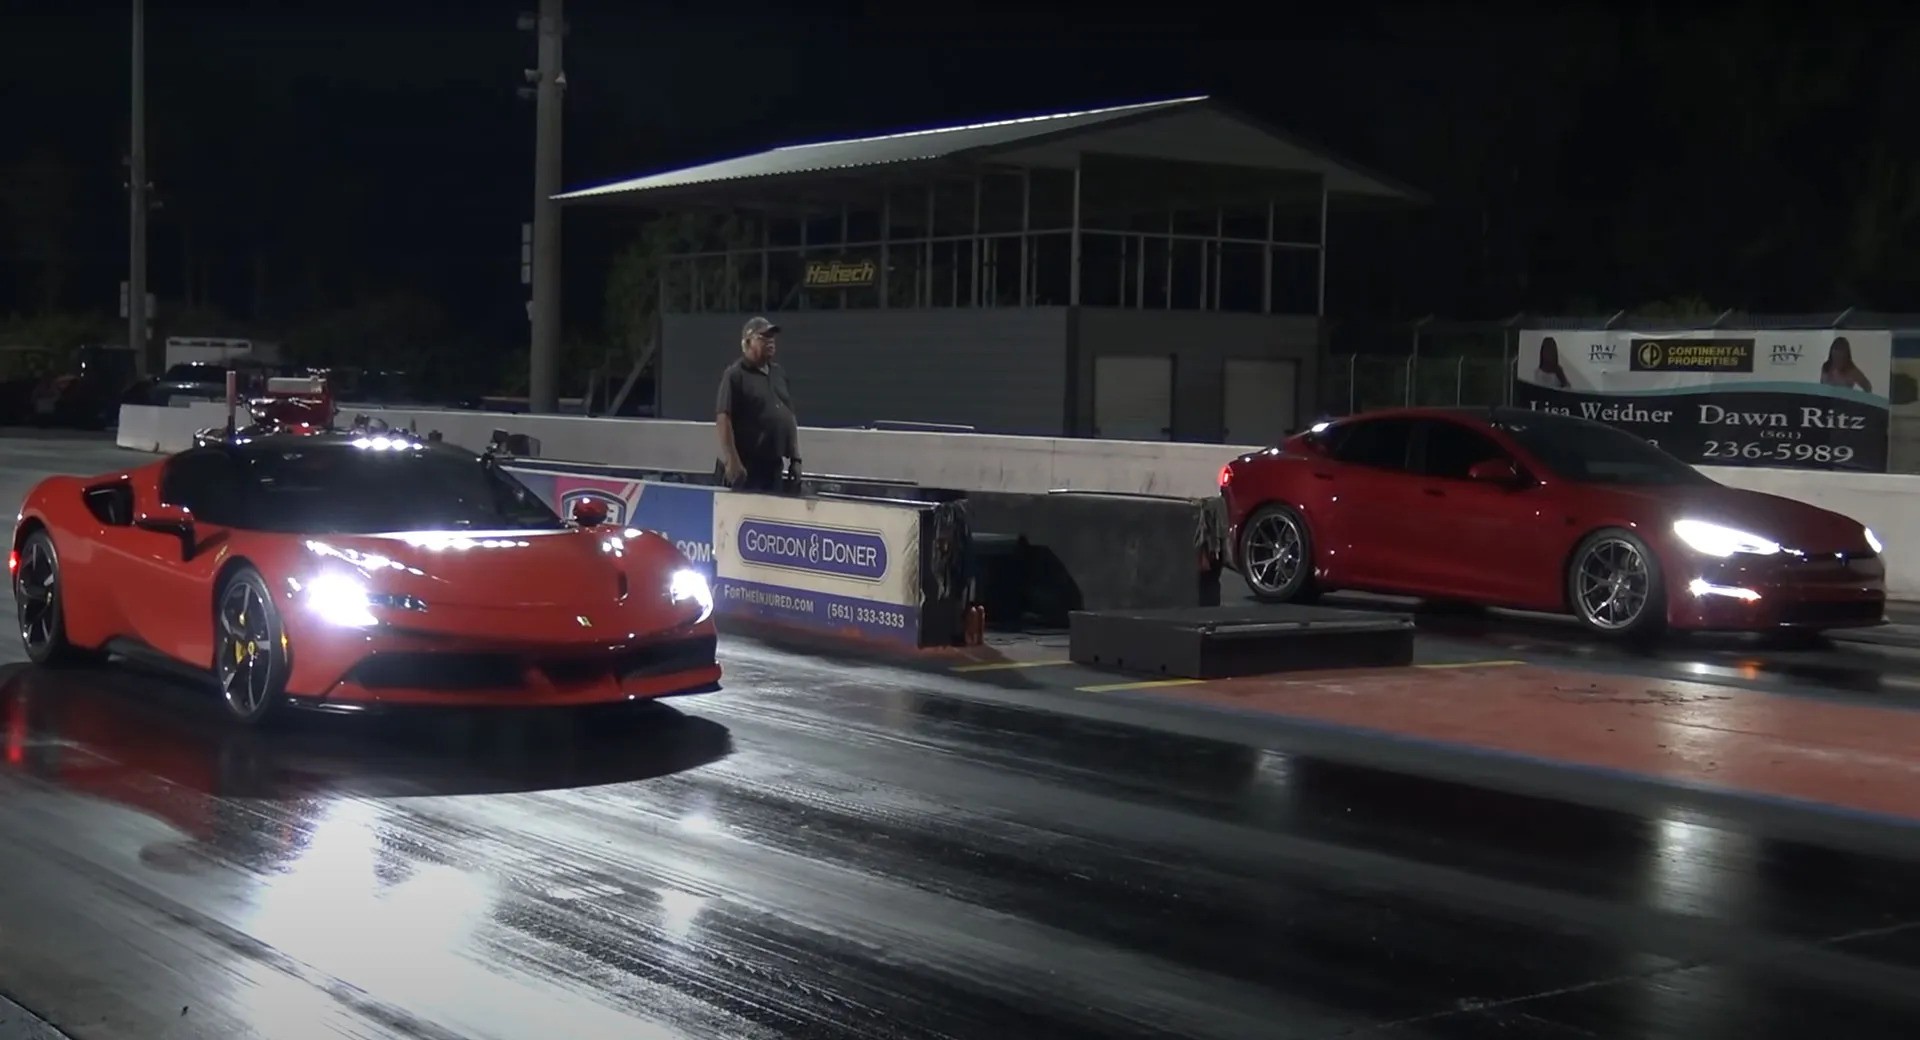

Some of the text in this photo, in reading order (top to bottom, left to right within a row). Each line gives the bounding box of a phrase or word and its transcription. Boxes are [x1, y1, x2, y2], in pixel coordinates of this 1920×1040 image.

[806, 263, 874, 283] Haltech
[1667, 356, 1738, 367] PROPERTIES
[1668, 346, 1747, 357] CONTINENTAL
[1580, 402, 1673, 423] Weidner
[1698, 404, 1866, 429] Dawn Ritz
[1760, 430, 1801, 440] (561)
[1702, 440, 1854, 463] 236-5989
[745, 529, 877, 567] GORDON & DONER
[827, 602, 853, 622] (561)
[857, 607, 905, 628] 333-3333
